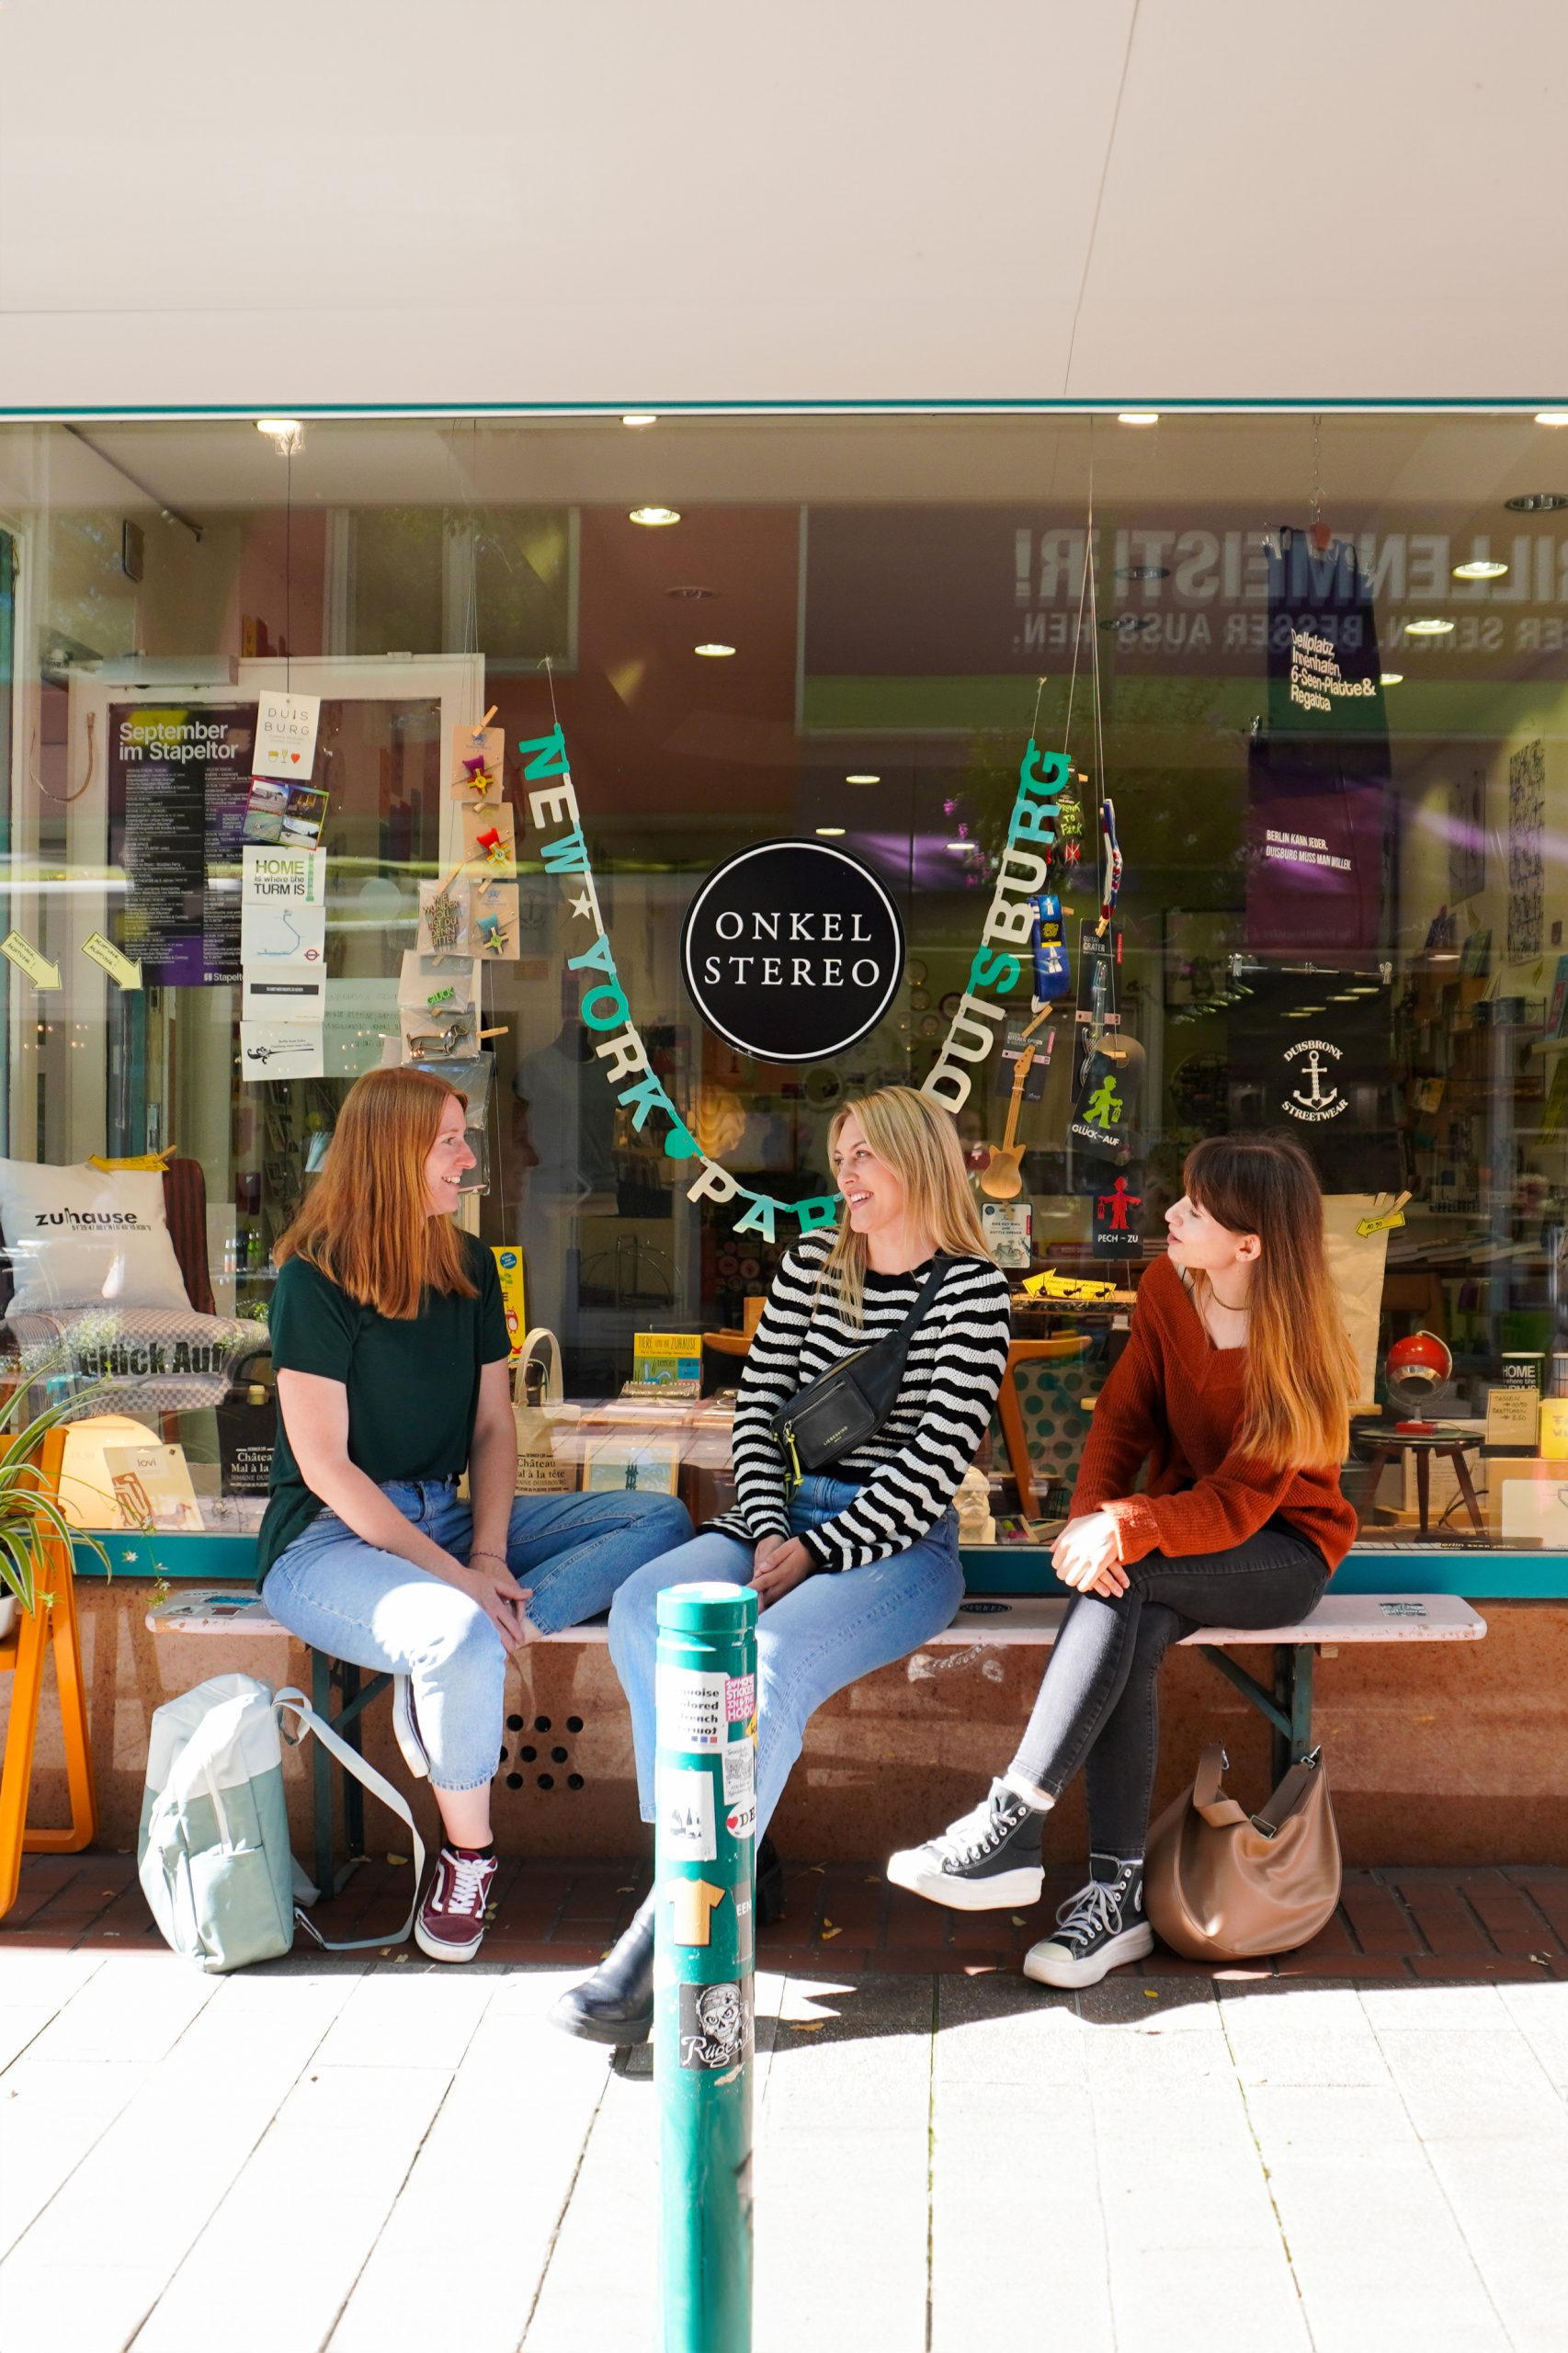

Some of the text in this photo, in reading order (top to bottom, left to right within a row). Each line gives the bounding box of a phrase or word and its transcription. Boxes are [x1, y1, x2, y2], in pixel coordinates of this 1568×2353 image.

[1290, 684, 1332, 711] Regatta
[267, 708, 309, 721] DUIS
[119, 722, 228, 745] September
[264, 722, 310, 735] BURG
[119, 741, 239, 765] im Stapeltor
[518, 732, 590, 874] NEW
[1267, 829, 1290, 843] BERLIN
[1290, 833, 1308, 847] KANN
[1266, 846, 1298, 860] DUISBURG
[1299, 849, 1316, 863] MUSS
[1316, 851, 1331, 866] MAN
[256, 859, 304, 875] HOME
[254, 883, 290, 895] TURM
[293, 883, 305, 895] IS
[432, 892, 449, 902] WIE
[423, 901, 459, 912] WUNDER
[430, 909, 450, 919] VOLL
[431, 926, 455, 938] DENN
[715, 911, 872, 942] ONKEL
[921, 746, 1072, 1114] DUISBURG
[1083, 942, 1106, 952] GRATER
[213, 972, 243, 984] Stapelt
[704, 956, 881, 987] STEREO
[567, 934, 676, 1132] YORK
[1282, 1040, 1344, 1062] DUISBRONX
[1281, 1098, 1349, 1121] STREETWEAR
[687, 1160, 838, 1244] PAR
[35, 1208, 138, 1227] zuhause
[1097, 1233, 1119, 1243] PECH
[1127, 1233, 1139, 1243] ZU
[1502, 1365, 1536, 1378] HOME
[237, 1452, 273, 1461] Châtea
[517, 1458, 556, 1468] Château
[231, 1463, 269, 1472] Mal à la
[517, 1470, 526, 1478] al
[537, 1470, 545, 1478] la
